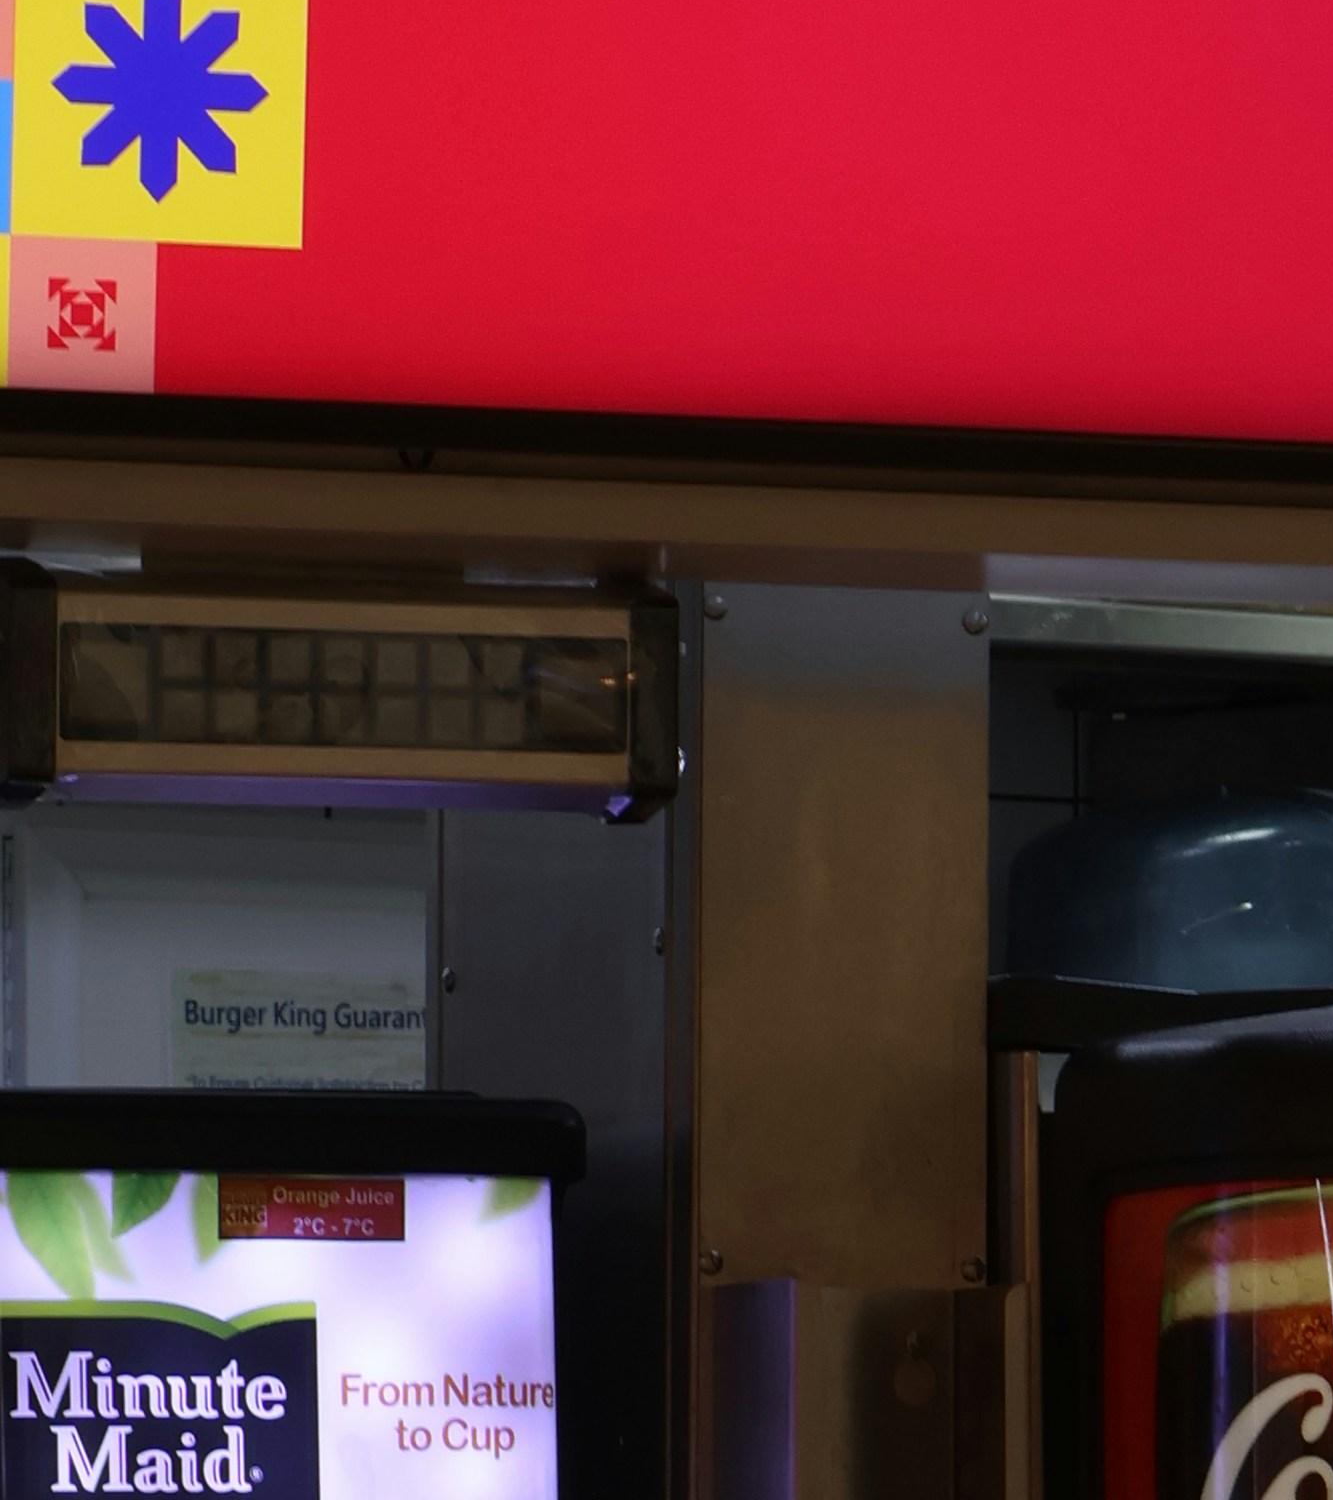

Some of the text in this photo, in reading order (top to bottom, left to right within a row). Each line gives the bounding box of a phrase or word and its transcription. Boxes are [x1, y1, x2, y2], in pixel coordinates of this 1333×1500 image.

[184, 999, 267, 1034] Burger
[273, 1001, 327, 1036] King
[272, 1185, 341, 1209] Orange
[345, 1186, 395, 1206] Juice
[8, 1349, 288, 1421] Minute
[340, 1372, 556, 1410] From Nature
[395, 1417, 516, 1461] to Cup
